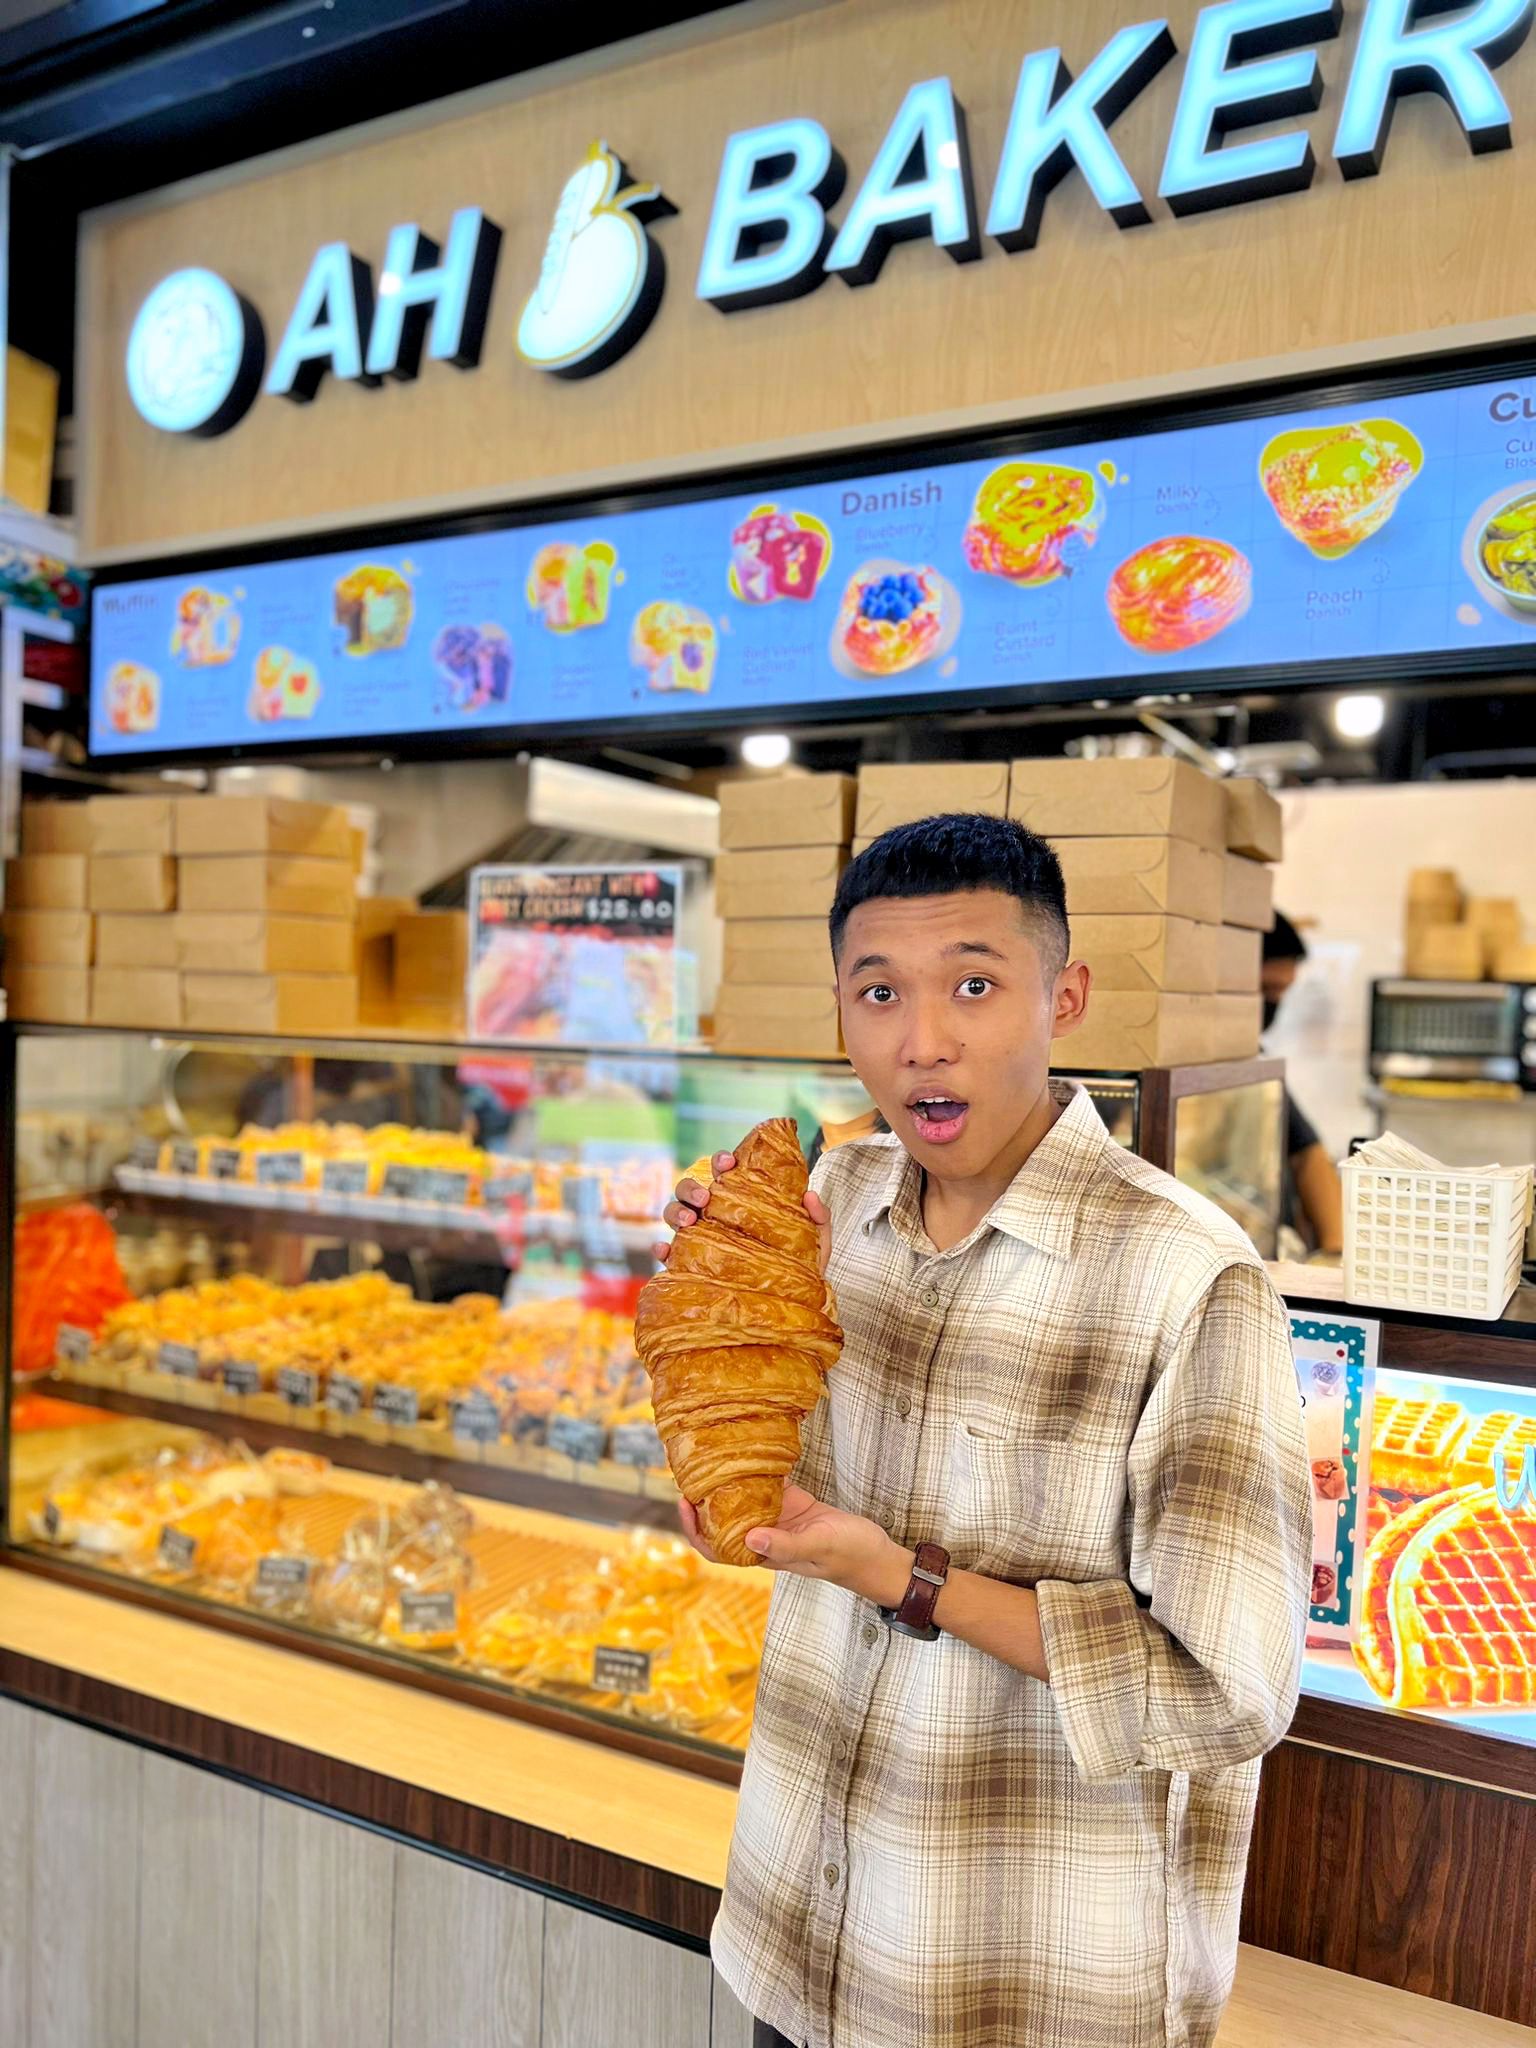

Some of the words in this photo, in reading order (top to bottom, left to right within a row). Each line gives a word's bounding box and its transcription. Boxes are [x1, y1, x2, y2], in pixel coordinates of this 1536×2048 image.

[265, 204, 483, 397] AH
[841, 480, 943, 516] Danish
[1156, 484, 1201, 501] Milky
[1306, 587, 1363, 606] Peach
